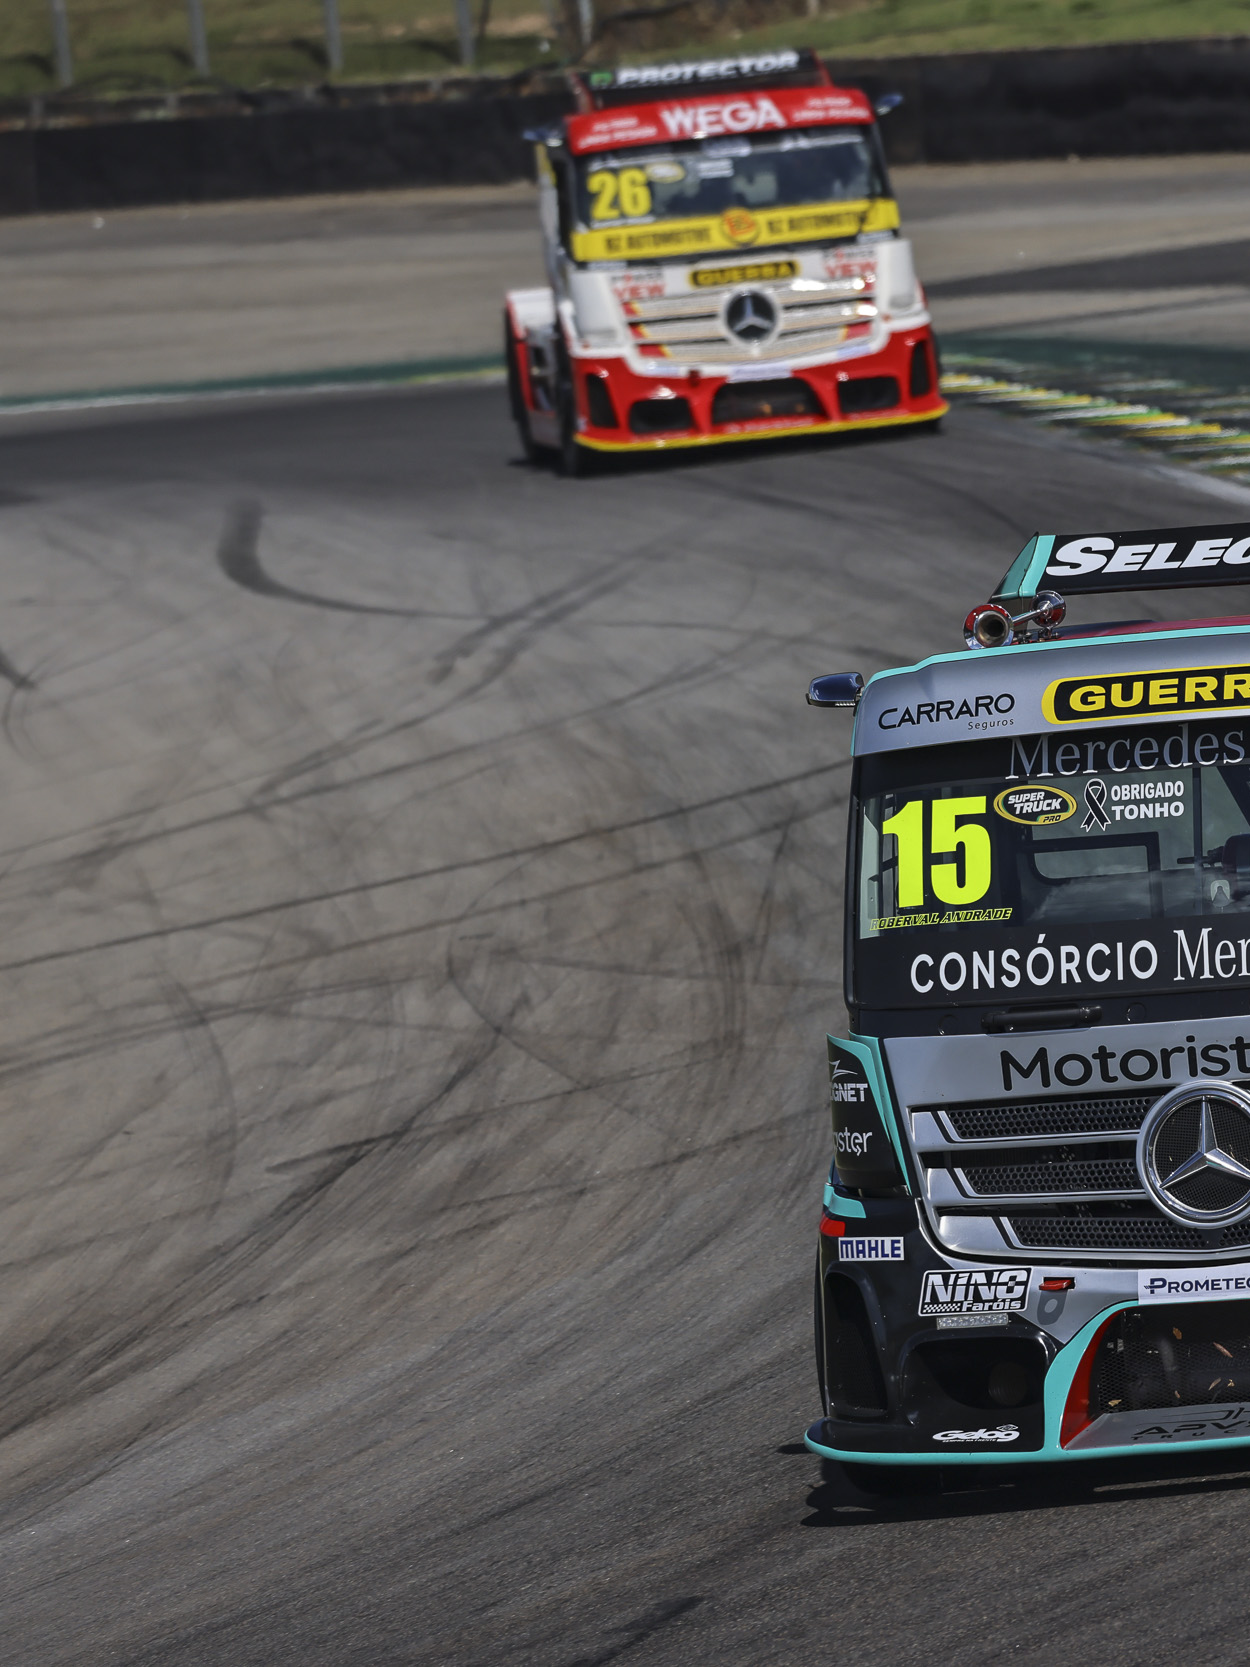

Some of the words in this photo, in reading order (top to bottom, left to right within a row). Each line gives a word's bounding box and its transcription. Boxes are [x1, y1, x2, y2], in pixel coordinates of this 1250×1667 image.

[615, 50, 800, 86] PROTECTOR
[660, 96, 787, 137] WEGA
[587, 167, 652, 221] 26
[878, 693, 1016, 730] CARRARO
[967, 718, 1015, 731] Seguros
[1005, 722, 1245, 779] Mercedes
[1007, 791, 1045, 805] SUPER
[1110, 780, 1184, 801] OBRIGADO
[1013, 798, 1063, 815] TRUCK
[1111, 801, 1185, 821] TONHO
[1043, 814, 1061, 823] PRO
[882, 795, 992, 908] 15
[870, 911, 940, 931] ROBERVAL
[940, 907, 1013, 925] ANDRADE
[910, 933, 1159, 993] CONSÓRCIO
[829, 1081, 868, 1102] GNET
[839, 1238, 902, 1260] MAHLE
[961, 1298, 1022, 1312] Faróis
